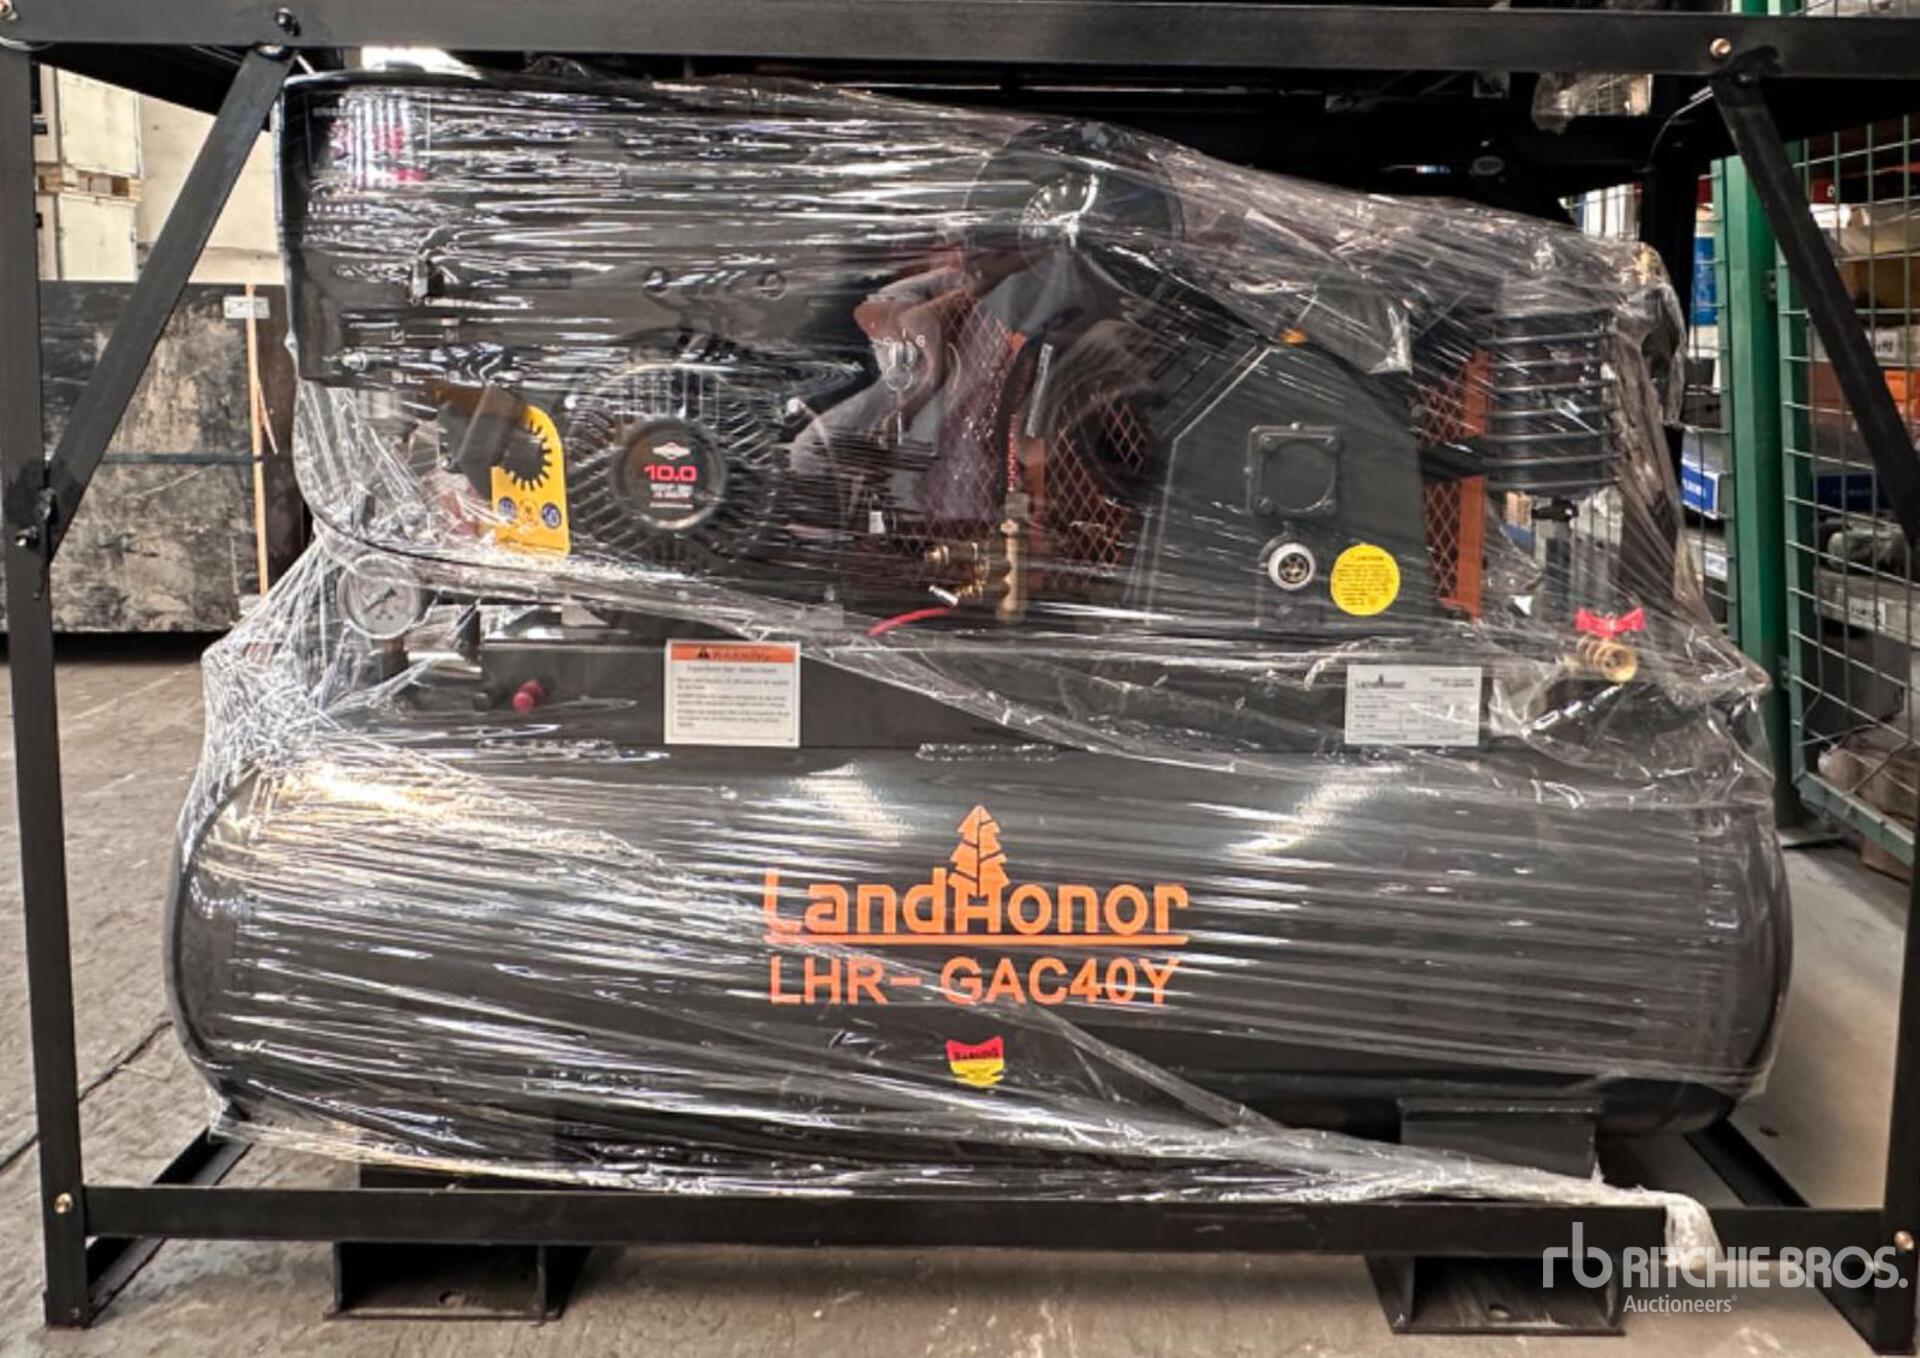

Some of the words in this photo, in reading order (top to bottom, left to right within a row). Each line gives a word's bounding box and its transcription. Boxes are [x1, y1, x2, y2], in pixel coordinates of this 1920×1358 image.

[644, 465, 698, 482] 10.0
[763, 862, 1189, 934] LandHonor
[769, 955, 921, 1005] LHR-
[940, 956, 1181, 1006] GAC40Y
